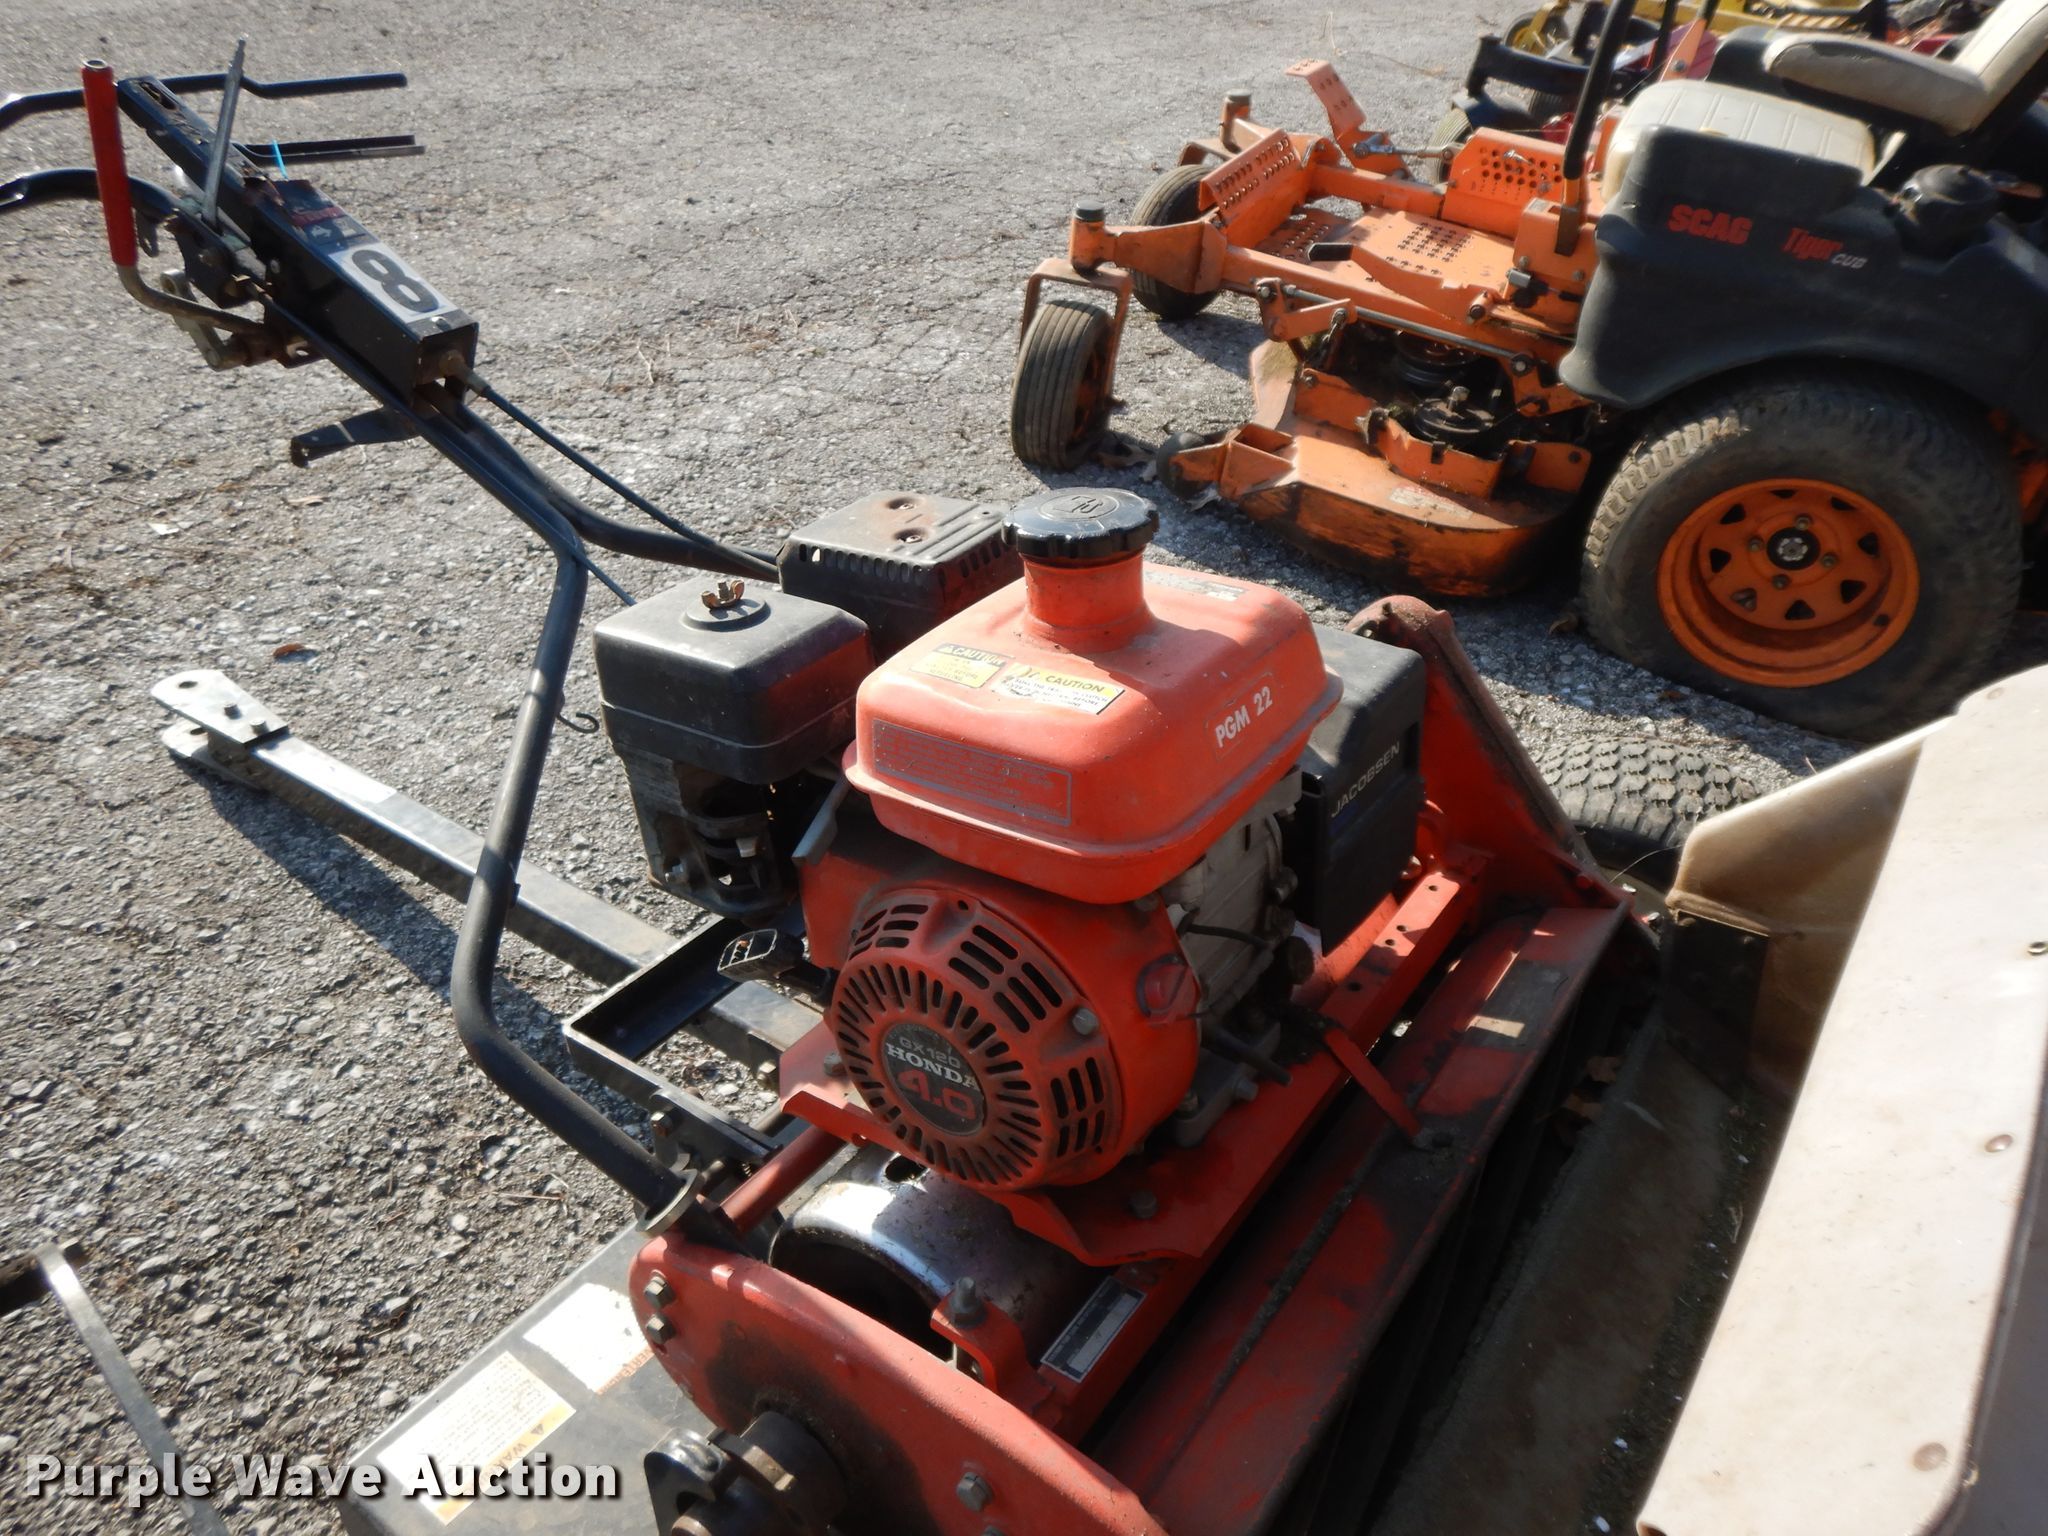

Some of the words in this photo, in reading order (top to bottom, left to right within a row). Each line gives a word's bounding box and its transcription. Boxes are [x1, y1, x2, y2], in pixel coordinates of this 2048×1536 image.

[1668, 203, 1753, 245] SCAG
[1781, 227, 1843, 260] Tiger
[351, 249, 439, 313] 8
[952, 644, 1005, 667] CAUTION
[1045, 675, 1104, 693] CAUTION
[1215, 705, 1251, 748] PGM
[1254, 686, 1273, 716] 22
[1331, 742, 1400, 818] JACOBSEN
[886, 1043, 981, 1092] HONDA
[898, 1069, 977, 1120] 4.0
